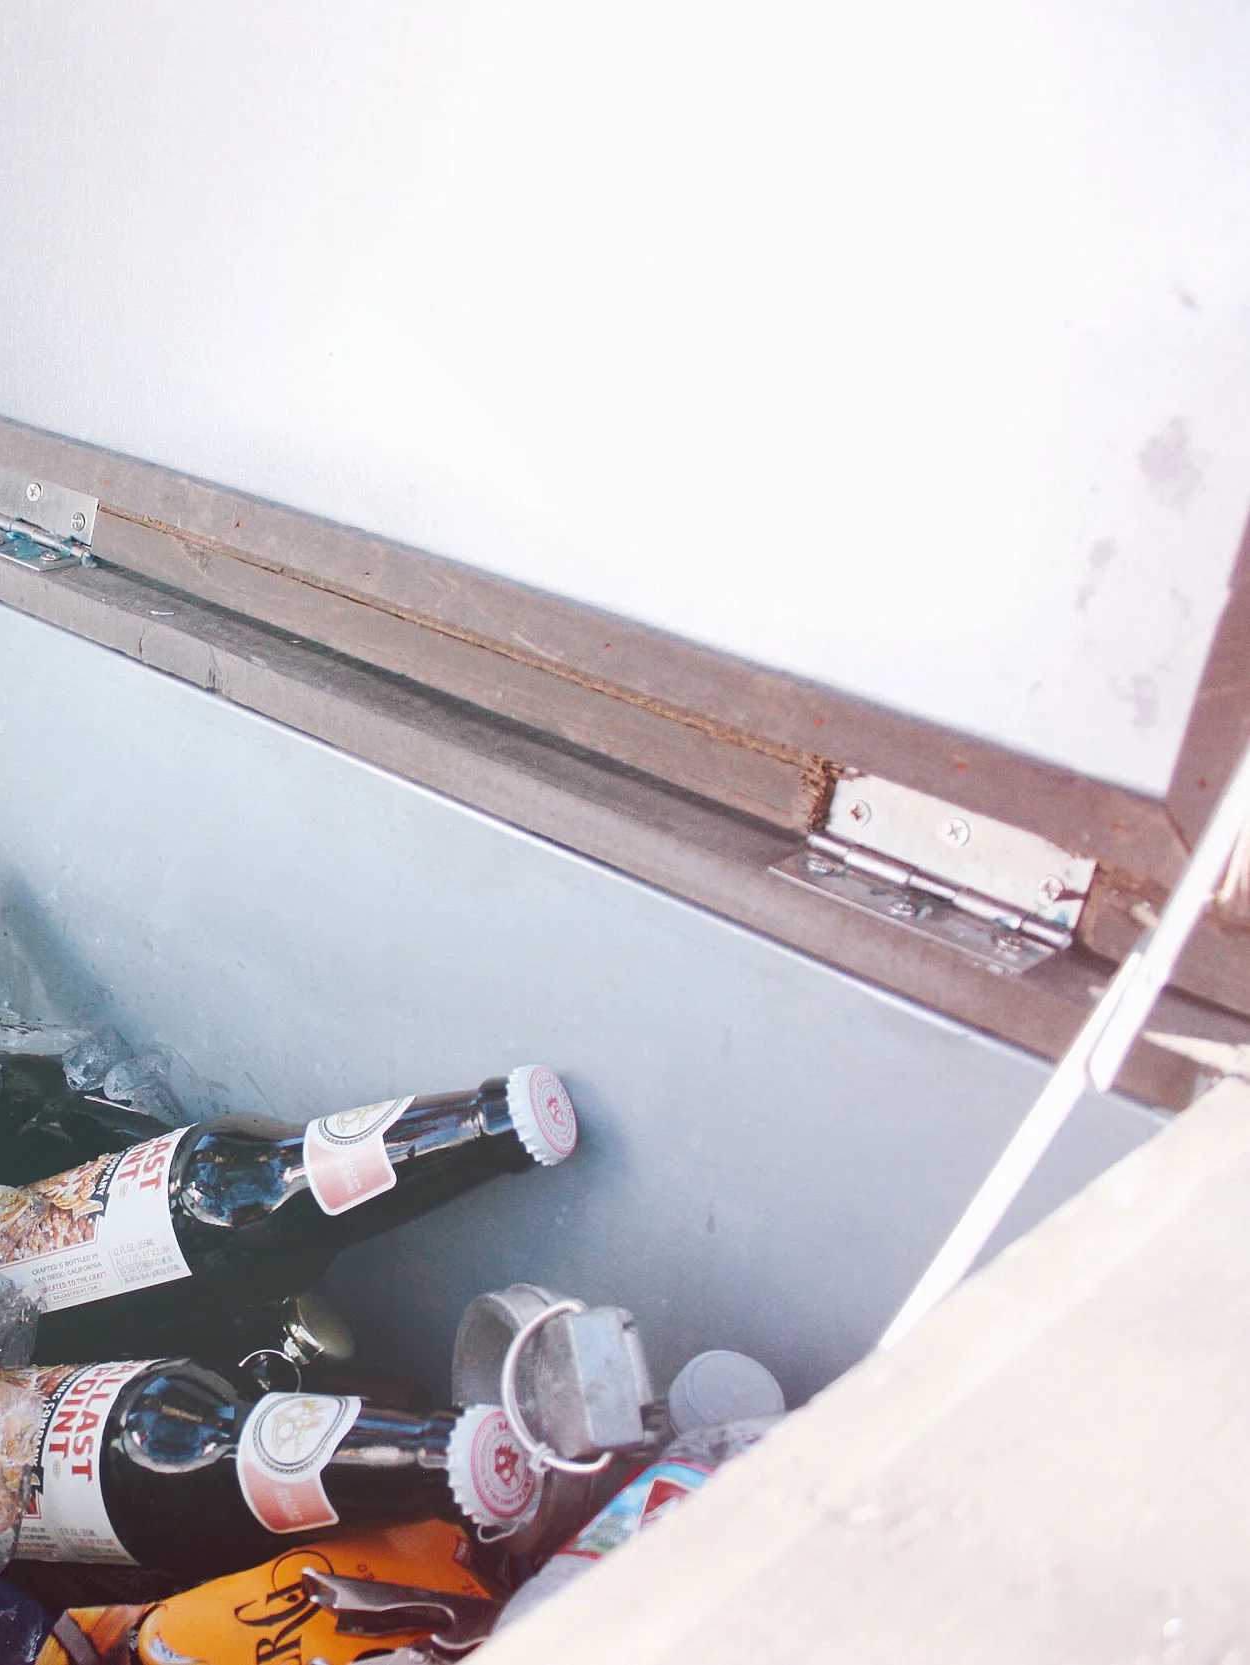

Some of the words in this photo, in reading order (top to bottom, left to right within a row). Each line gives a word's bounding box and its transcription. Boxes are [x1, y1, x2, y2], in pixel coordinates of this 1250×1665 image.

[32, 1264, 58, 1275] CRAFTED
[64, 1255, 91, 1267] BOTTLED
[92, 1252, 100, 1260] IN
[66, 1262, 102, 1276] CALIFORNIA
[67, 1279, 76, 1287] TO
[77, 1277, 88, 1285] THE
[89, 1271, 108, 1282] CRAFT
